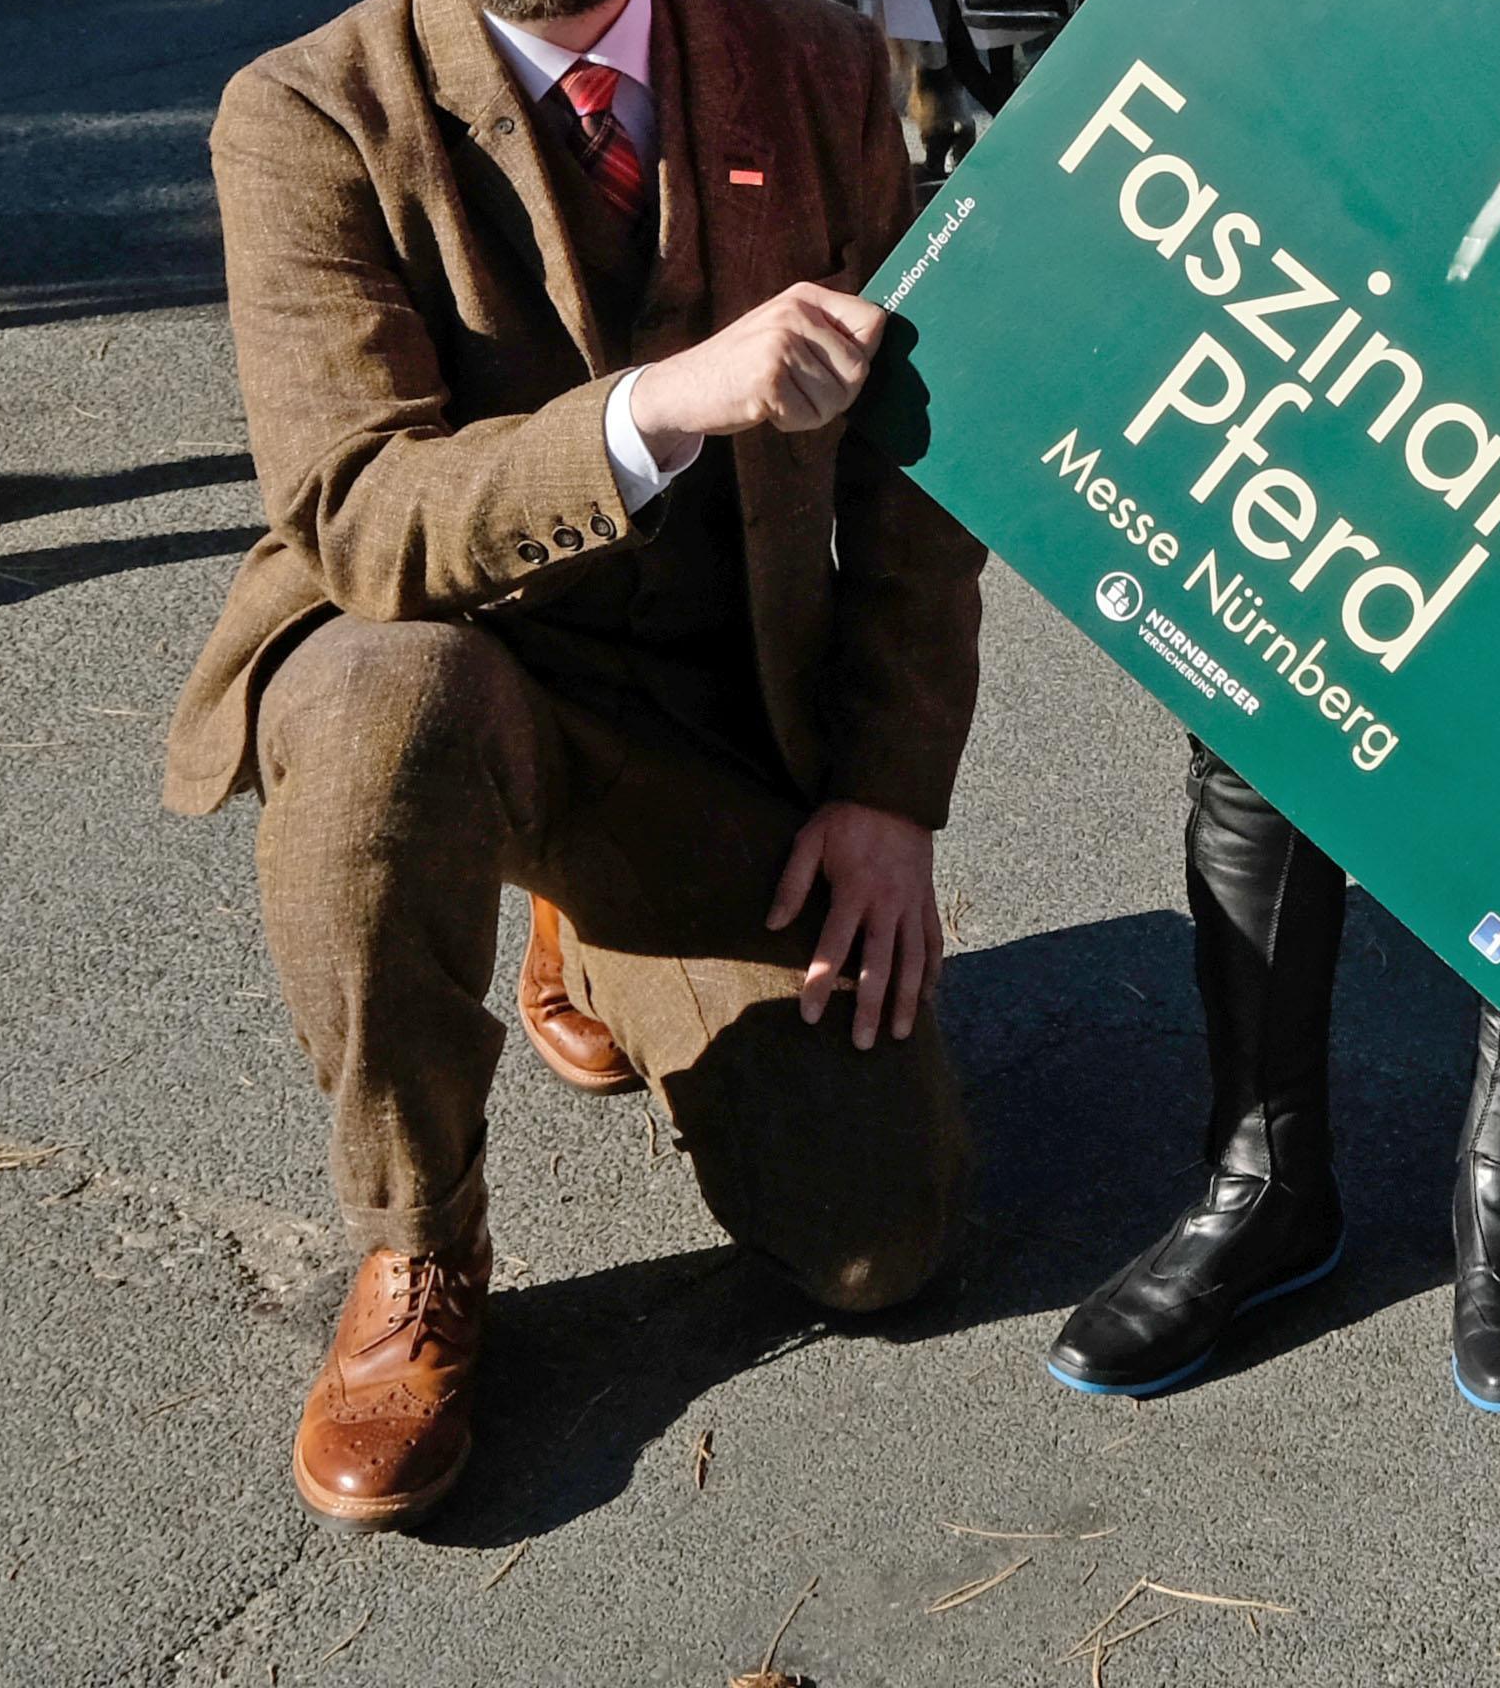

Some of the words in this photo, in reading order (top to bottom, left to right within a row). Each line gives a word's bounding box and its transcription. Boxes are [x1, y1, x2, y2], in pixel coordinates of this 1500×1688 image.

[1041, 428, 1178, 566] Messe
[1183, 549, 1398, 770] Nürnberg
[1124, 332, 1489, 672] Pferd
[1138, 624, 1217, 700] VERSICHERUNG
[1145, 608, 1260, 716] NÜRNBERGER
